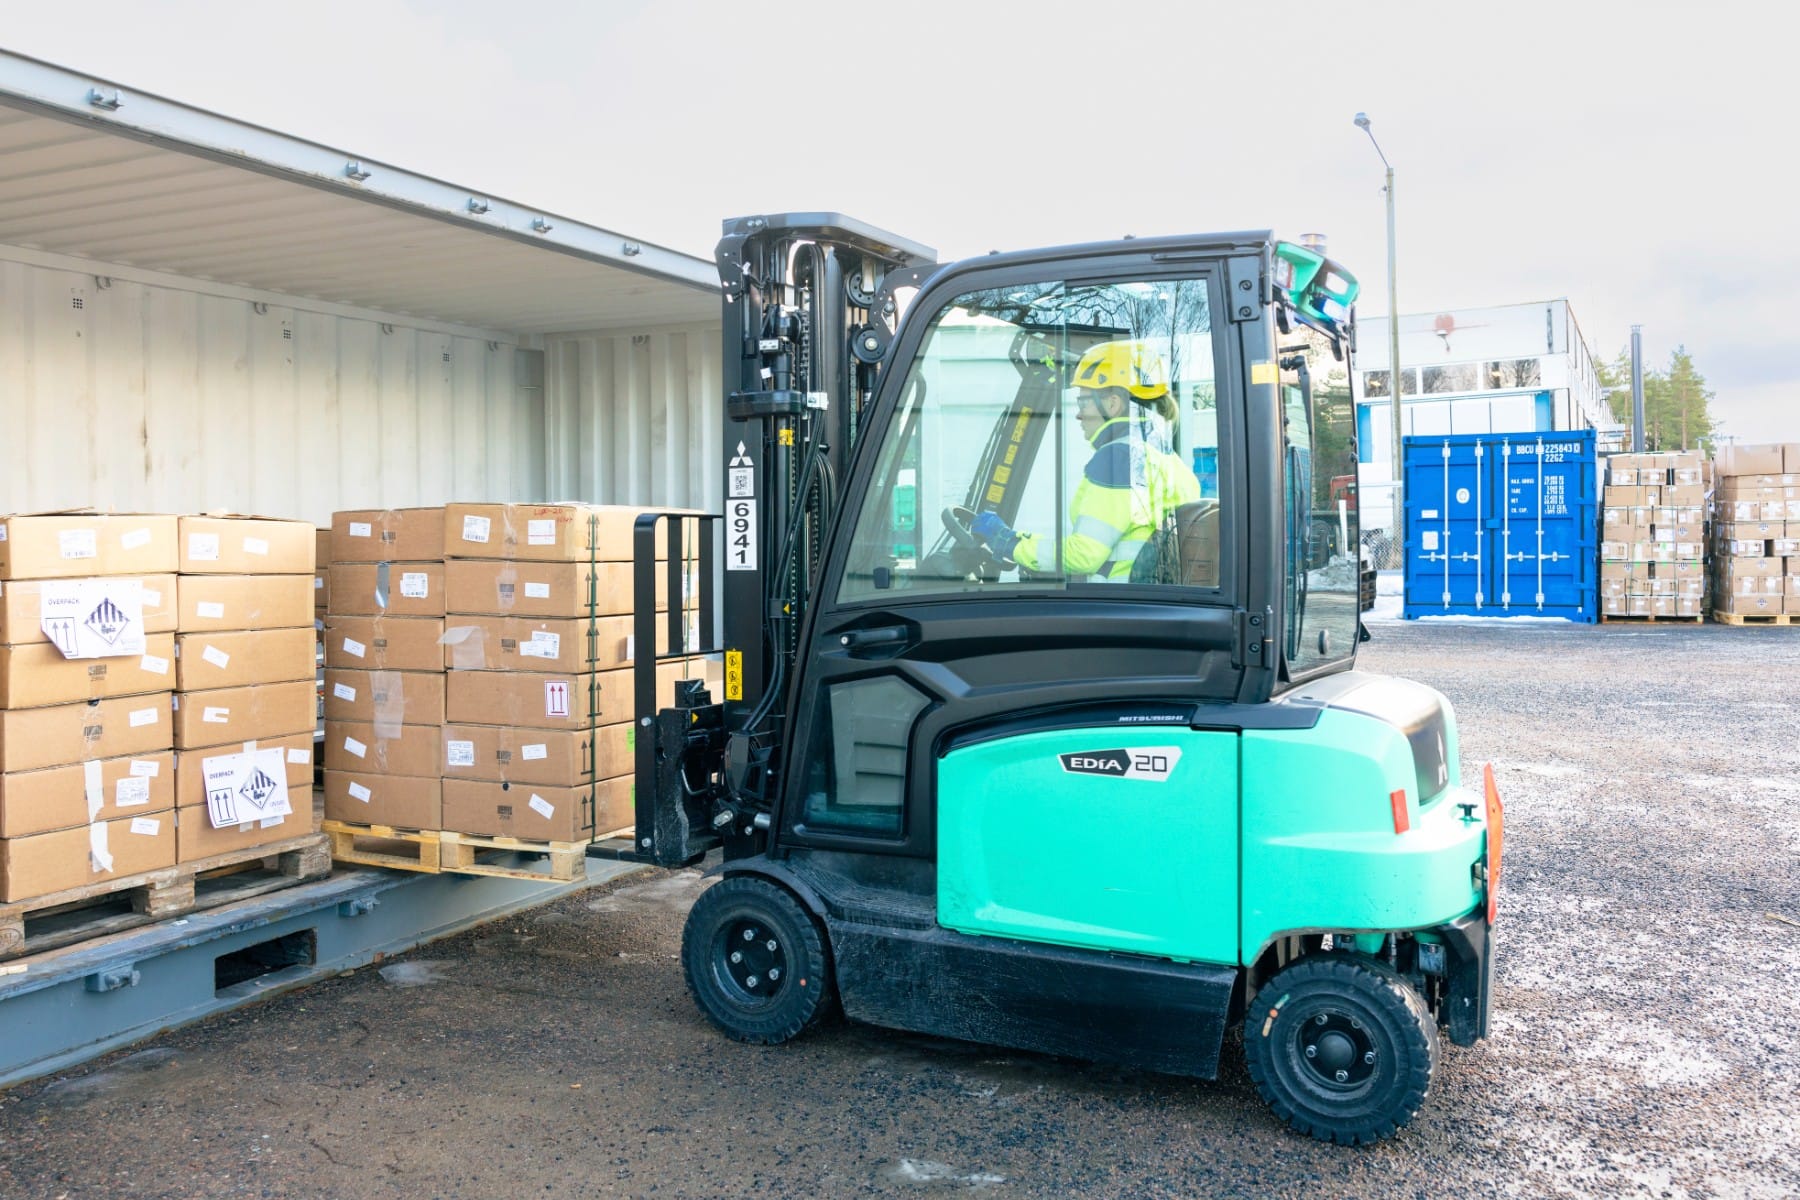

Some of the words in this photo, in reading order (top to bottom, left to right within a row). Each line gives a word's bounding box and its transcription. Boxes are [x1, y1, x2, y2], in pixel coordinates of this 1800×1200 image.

[733, 502, 750, 564] 6941
[1135, 754, 1167, 772] 20
[209, 770, 234, 779] OVERPACK
